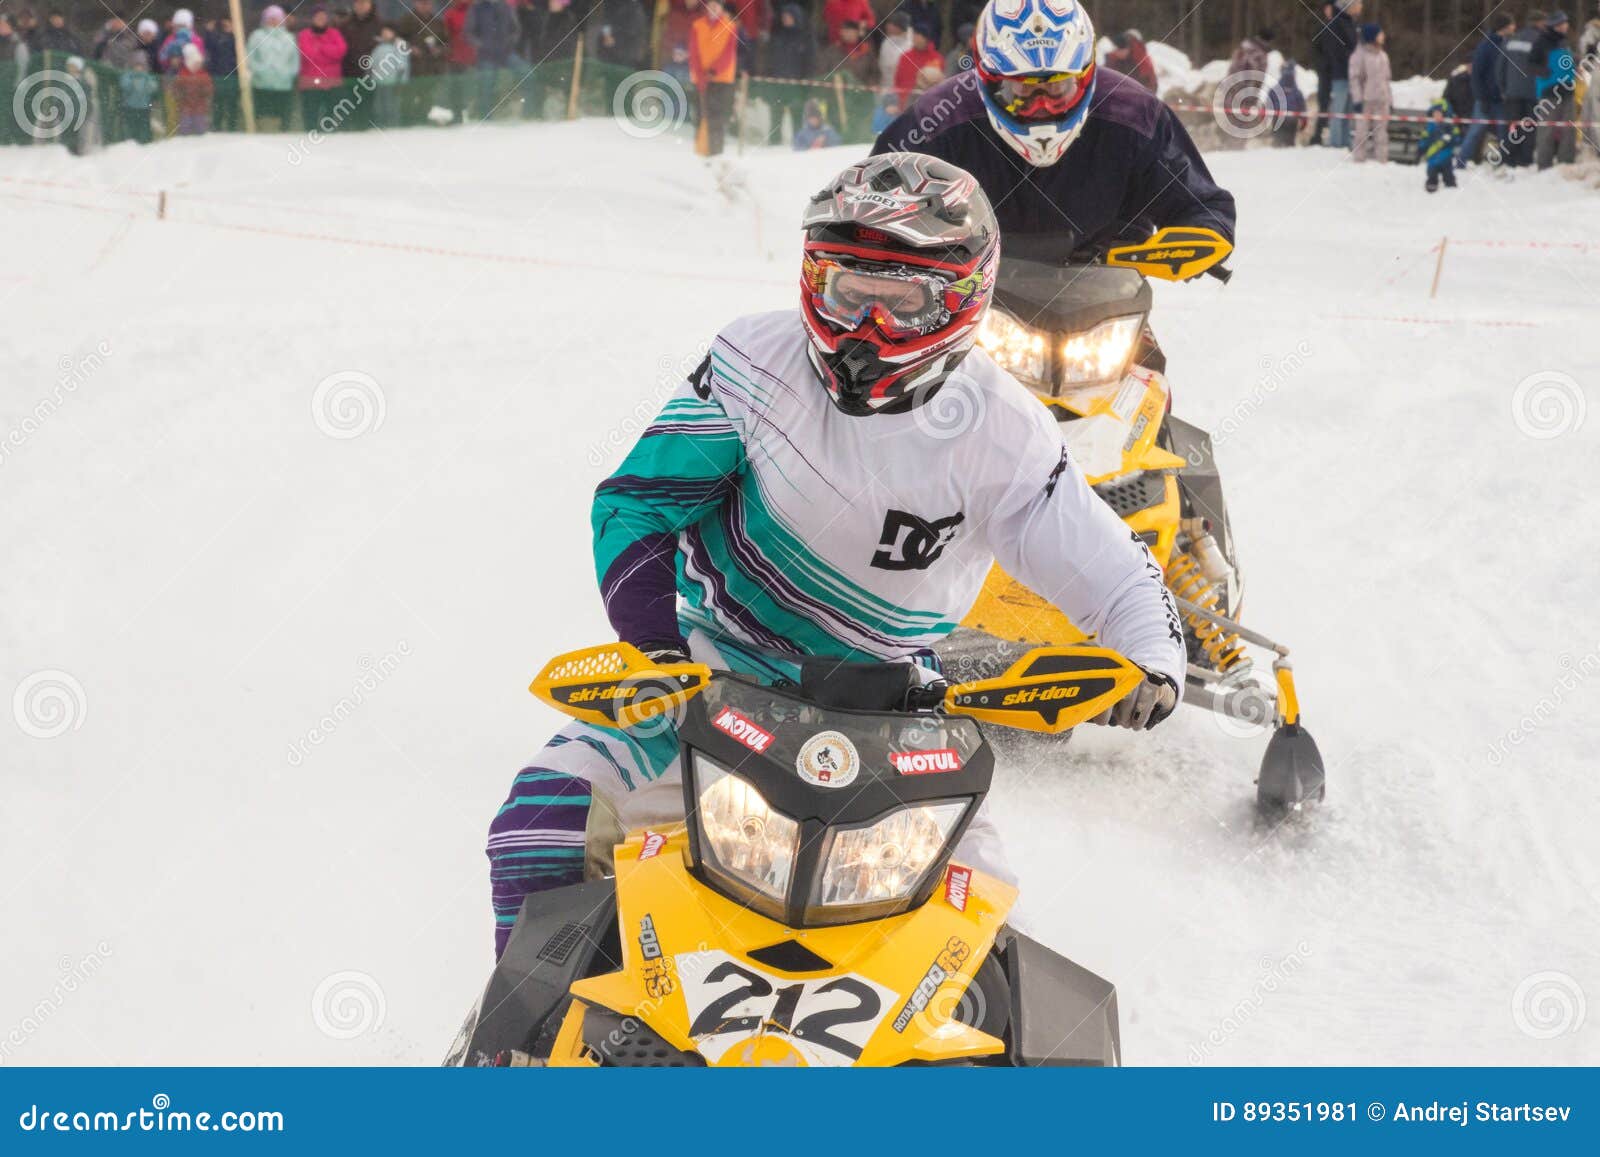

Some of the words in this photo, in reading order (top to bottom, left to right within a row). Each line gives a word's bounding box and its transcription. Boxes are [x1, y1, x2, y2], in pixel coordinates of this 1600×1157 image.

[1145, 249, 1196, 261] ski-doo
[568, 686, 637, 704] ski-doo
[1002, 686, 1080, 706] ski-doo
[715, 710, 771, 752] MOTUL
[896, 752, 960, 773] MOTUL
[688, 960, 882, 1062] 212
[893, 1000, 918, 1034] ROTAX
